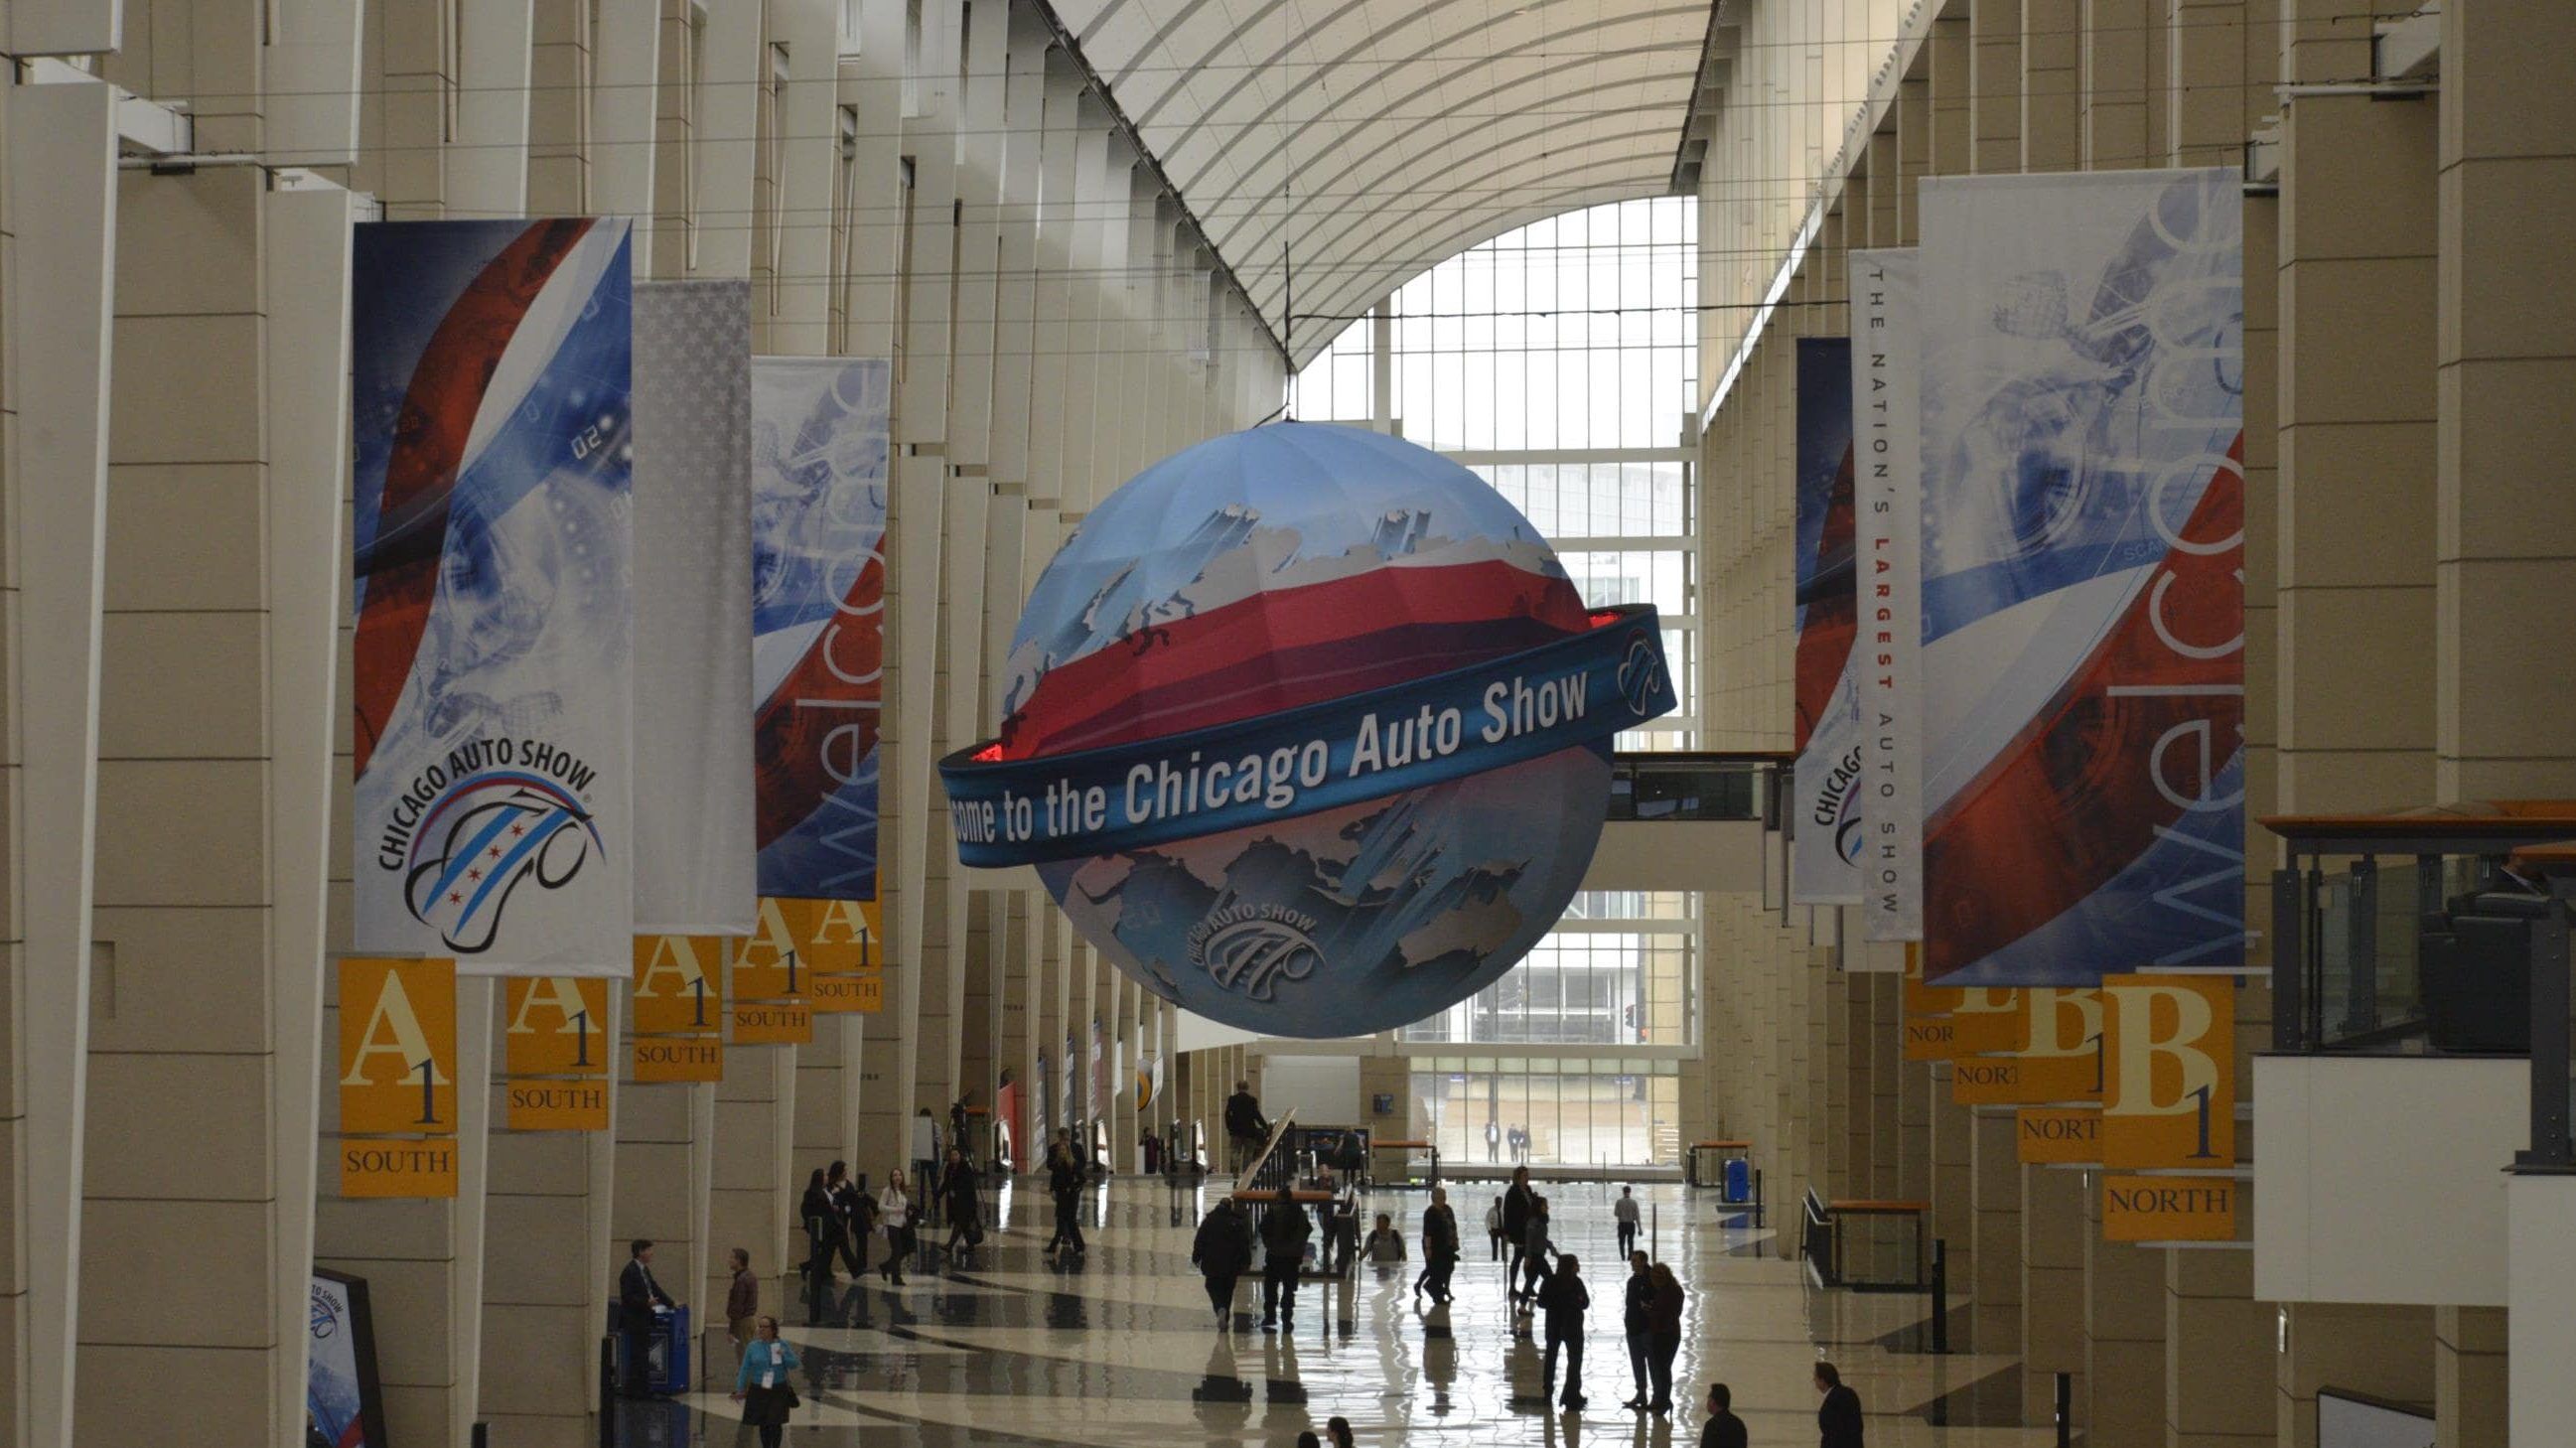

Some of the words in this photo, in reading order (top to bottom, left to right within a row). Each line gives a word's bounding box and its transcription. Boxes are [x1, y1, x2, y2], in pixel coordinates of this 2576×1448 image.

[1868, 269, 1886, 329] THE
[571, 425, 603, 460] 02
[1870, 354, 1896, 513] NATION'S
[1874, 538, 1893, 688] LARGEST
[1005, 788, 1033, 841] to
[1047, 778, 1105, 837] the
[1125, 738, 1329, 825] Chicago
[1349, 702, 1462, 777] Auto
[1483, 670, 1588, 743] Show
[1878, 714, 1896, 798] AUTO
[378, 764, 448, 872] CHICAGO
[450, 737, 513, 780] AUTO
[521, 739, 597, 792] SHOW
[1881, 822, 1898, 913] SHOW
[1210, 903, 1255, 931] AUTO
[1261, 905, 1318, 933] SHOW
[814, 983, 878, 998] SOUTH
[736, 1011, 806, 1028] SOUTH
[1909, 1026, 1953, 1042] NOR
[638, 1046, 716, 1066] SOUTH
[511, 1088, 601, 1110] SOUTH
[2023, 1118, 2100, 1141] NORT
[347, 1149, 451, 1174] SOUTH
[2108, 1188, 2227, 1214] NORTH
[322, 1290, 344, 1314] SHOW
